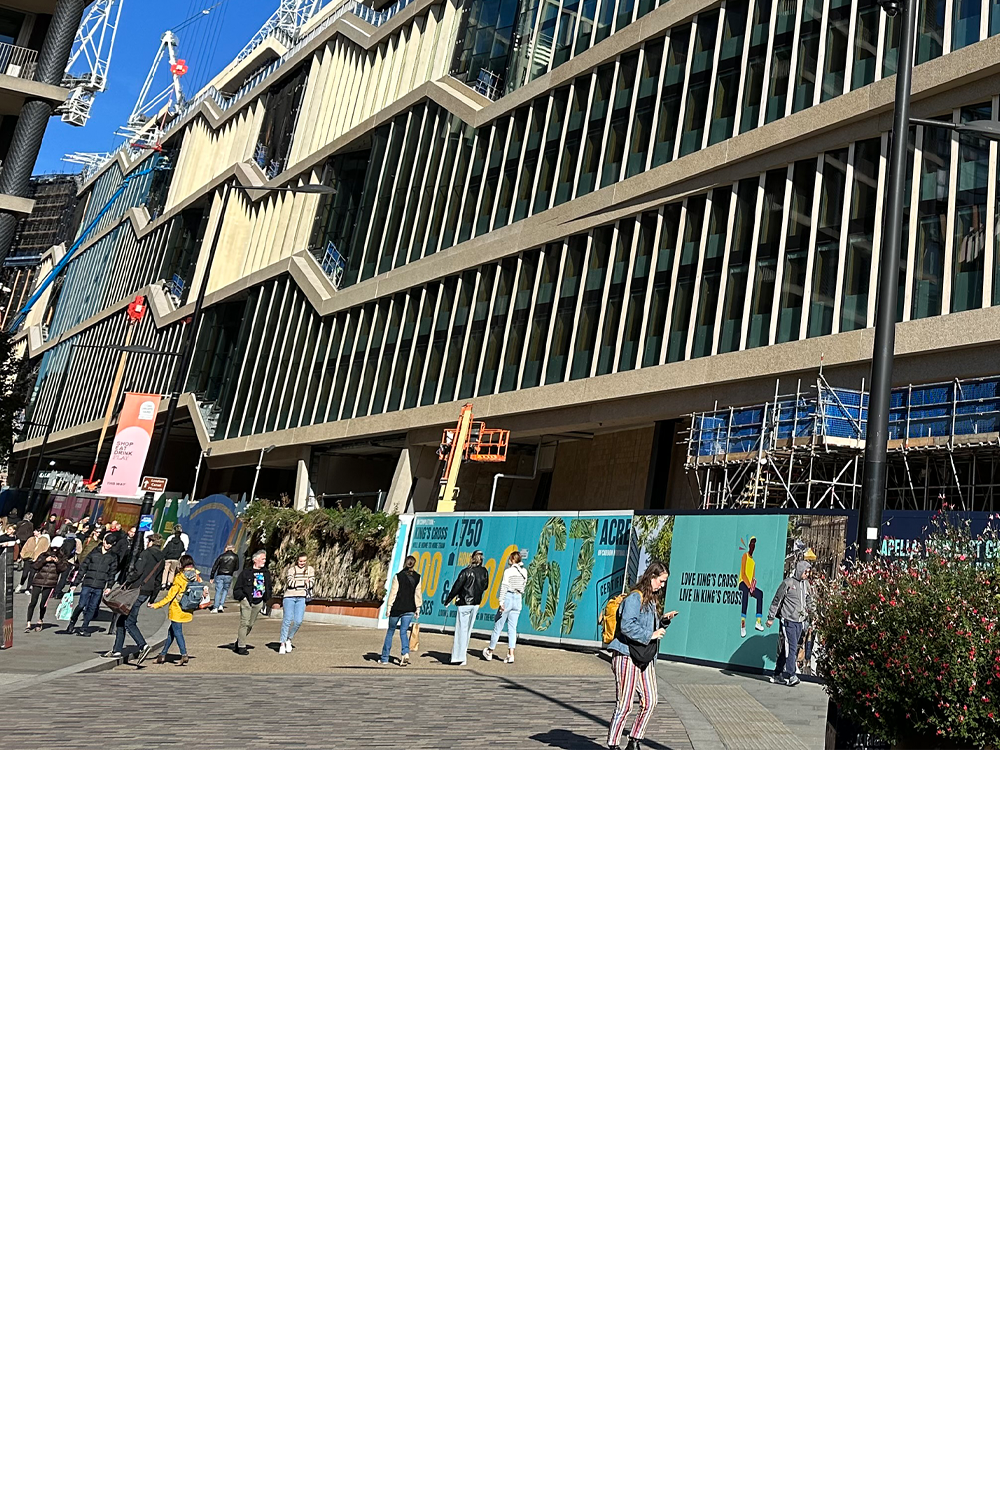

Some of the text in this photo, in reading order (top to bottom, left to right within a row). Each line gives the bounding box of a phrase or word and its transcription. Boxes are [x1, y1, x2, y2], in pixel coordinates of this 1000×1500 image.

[414, 526, 449, 540] KING'S CROSS
[524, 516, 598, 635] 67
[681, 572, 738, 588] LOVE KING'S CROSS
[679, 588, 743, 605] LIVE IN KING'S CROSS
